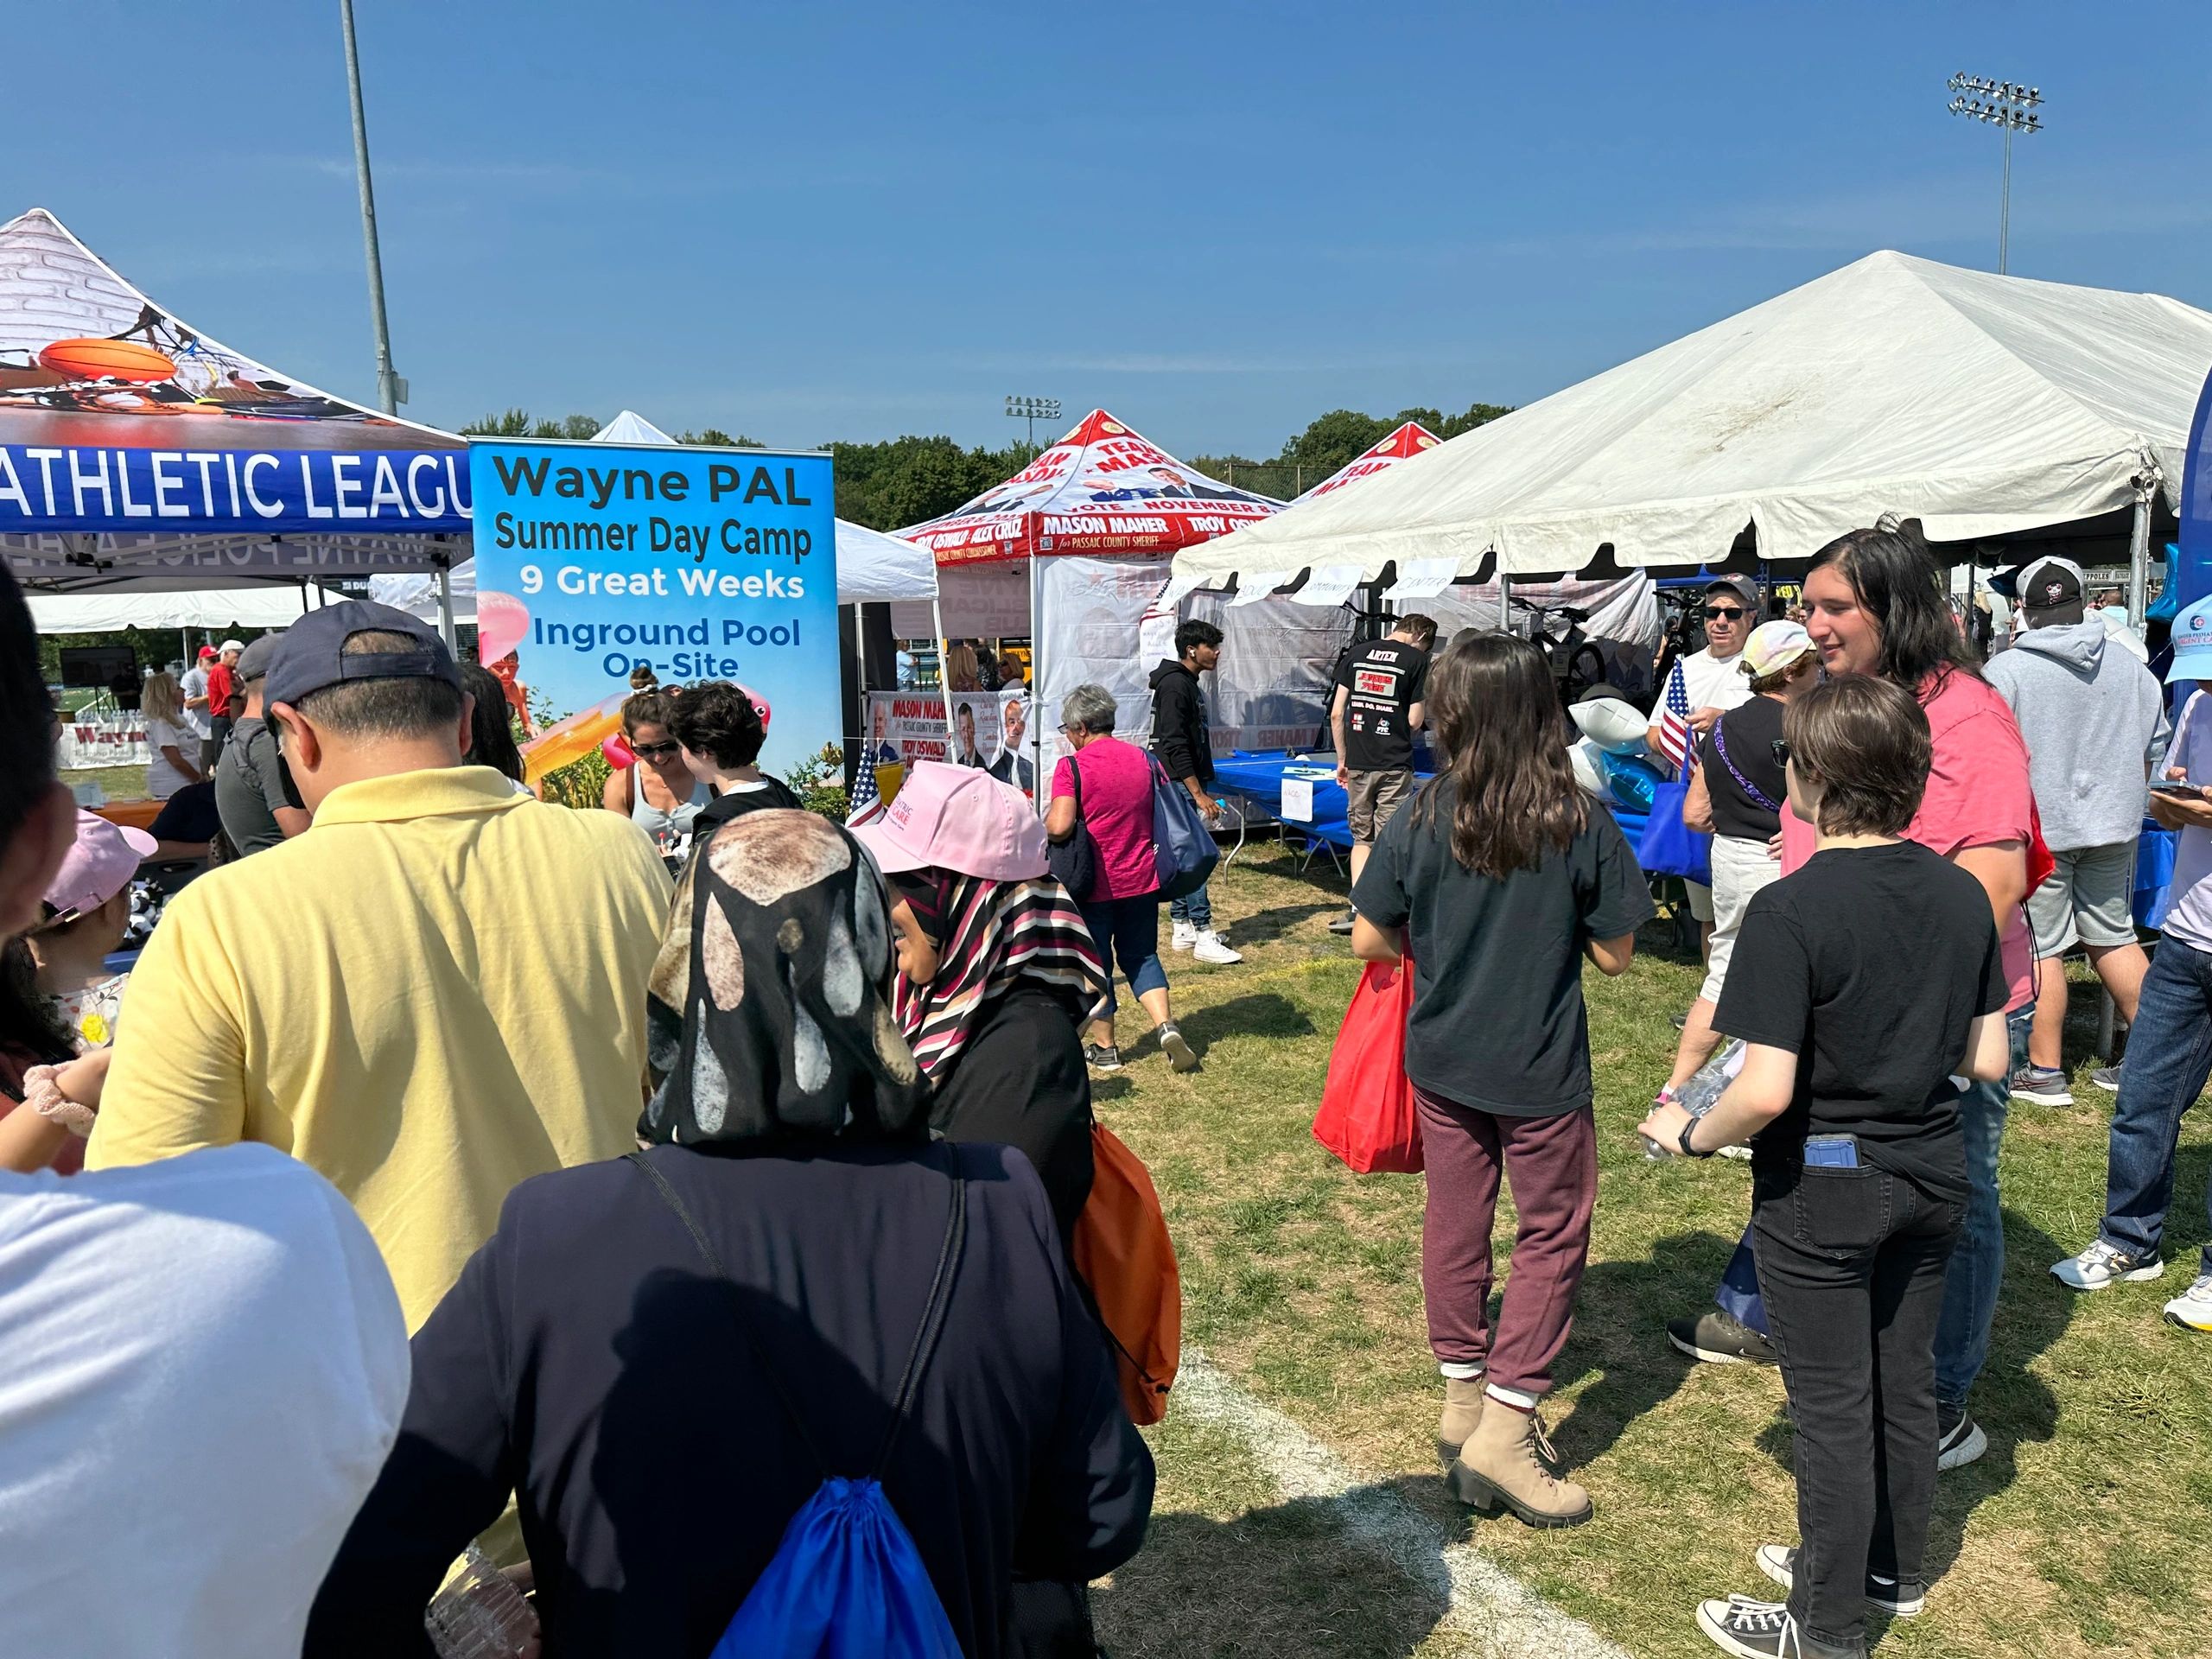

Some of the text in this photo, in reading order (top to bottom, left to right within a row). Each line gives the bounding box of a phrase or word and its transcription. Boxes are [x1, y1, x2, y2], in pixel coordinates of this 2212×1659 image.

[492, 455, 812, 510] Wayne PAL
[1143, 501, 1255, 514] NOVEMBER
[970, 524, 997, 544] ALEX
[995, 518, 1024, 541] CRUZ
[1043, 517, 1109, 535] MASON
[1110, 517, 1170, 534] MAHER
[1187, 517, 1226, 532] TROY
[495, 512, 812, 565] Summer Day Camp
[1058, 535, 1160, 550] for PASSAIC COUNTY SHERIFF
[520, 563, 804, 599] 9 Great Weeks
[534, 617, 800, 652] Inground Pool
[603, 652, 739, 678] On-Site
[1366, 649, 1399, 663] ARTEM
[893, 700, 921, 719] MASON
[902, 740, 946, 757] TROY OSWALD
